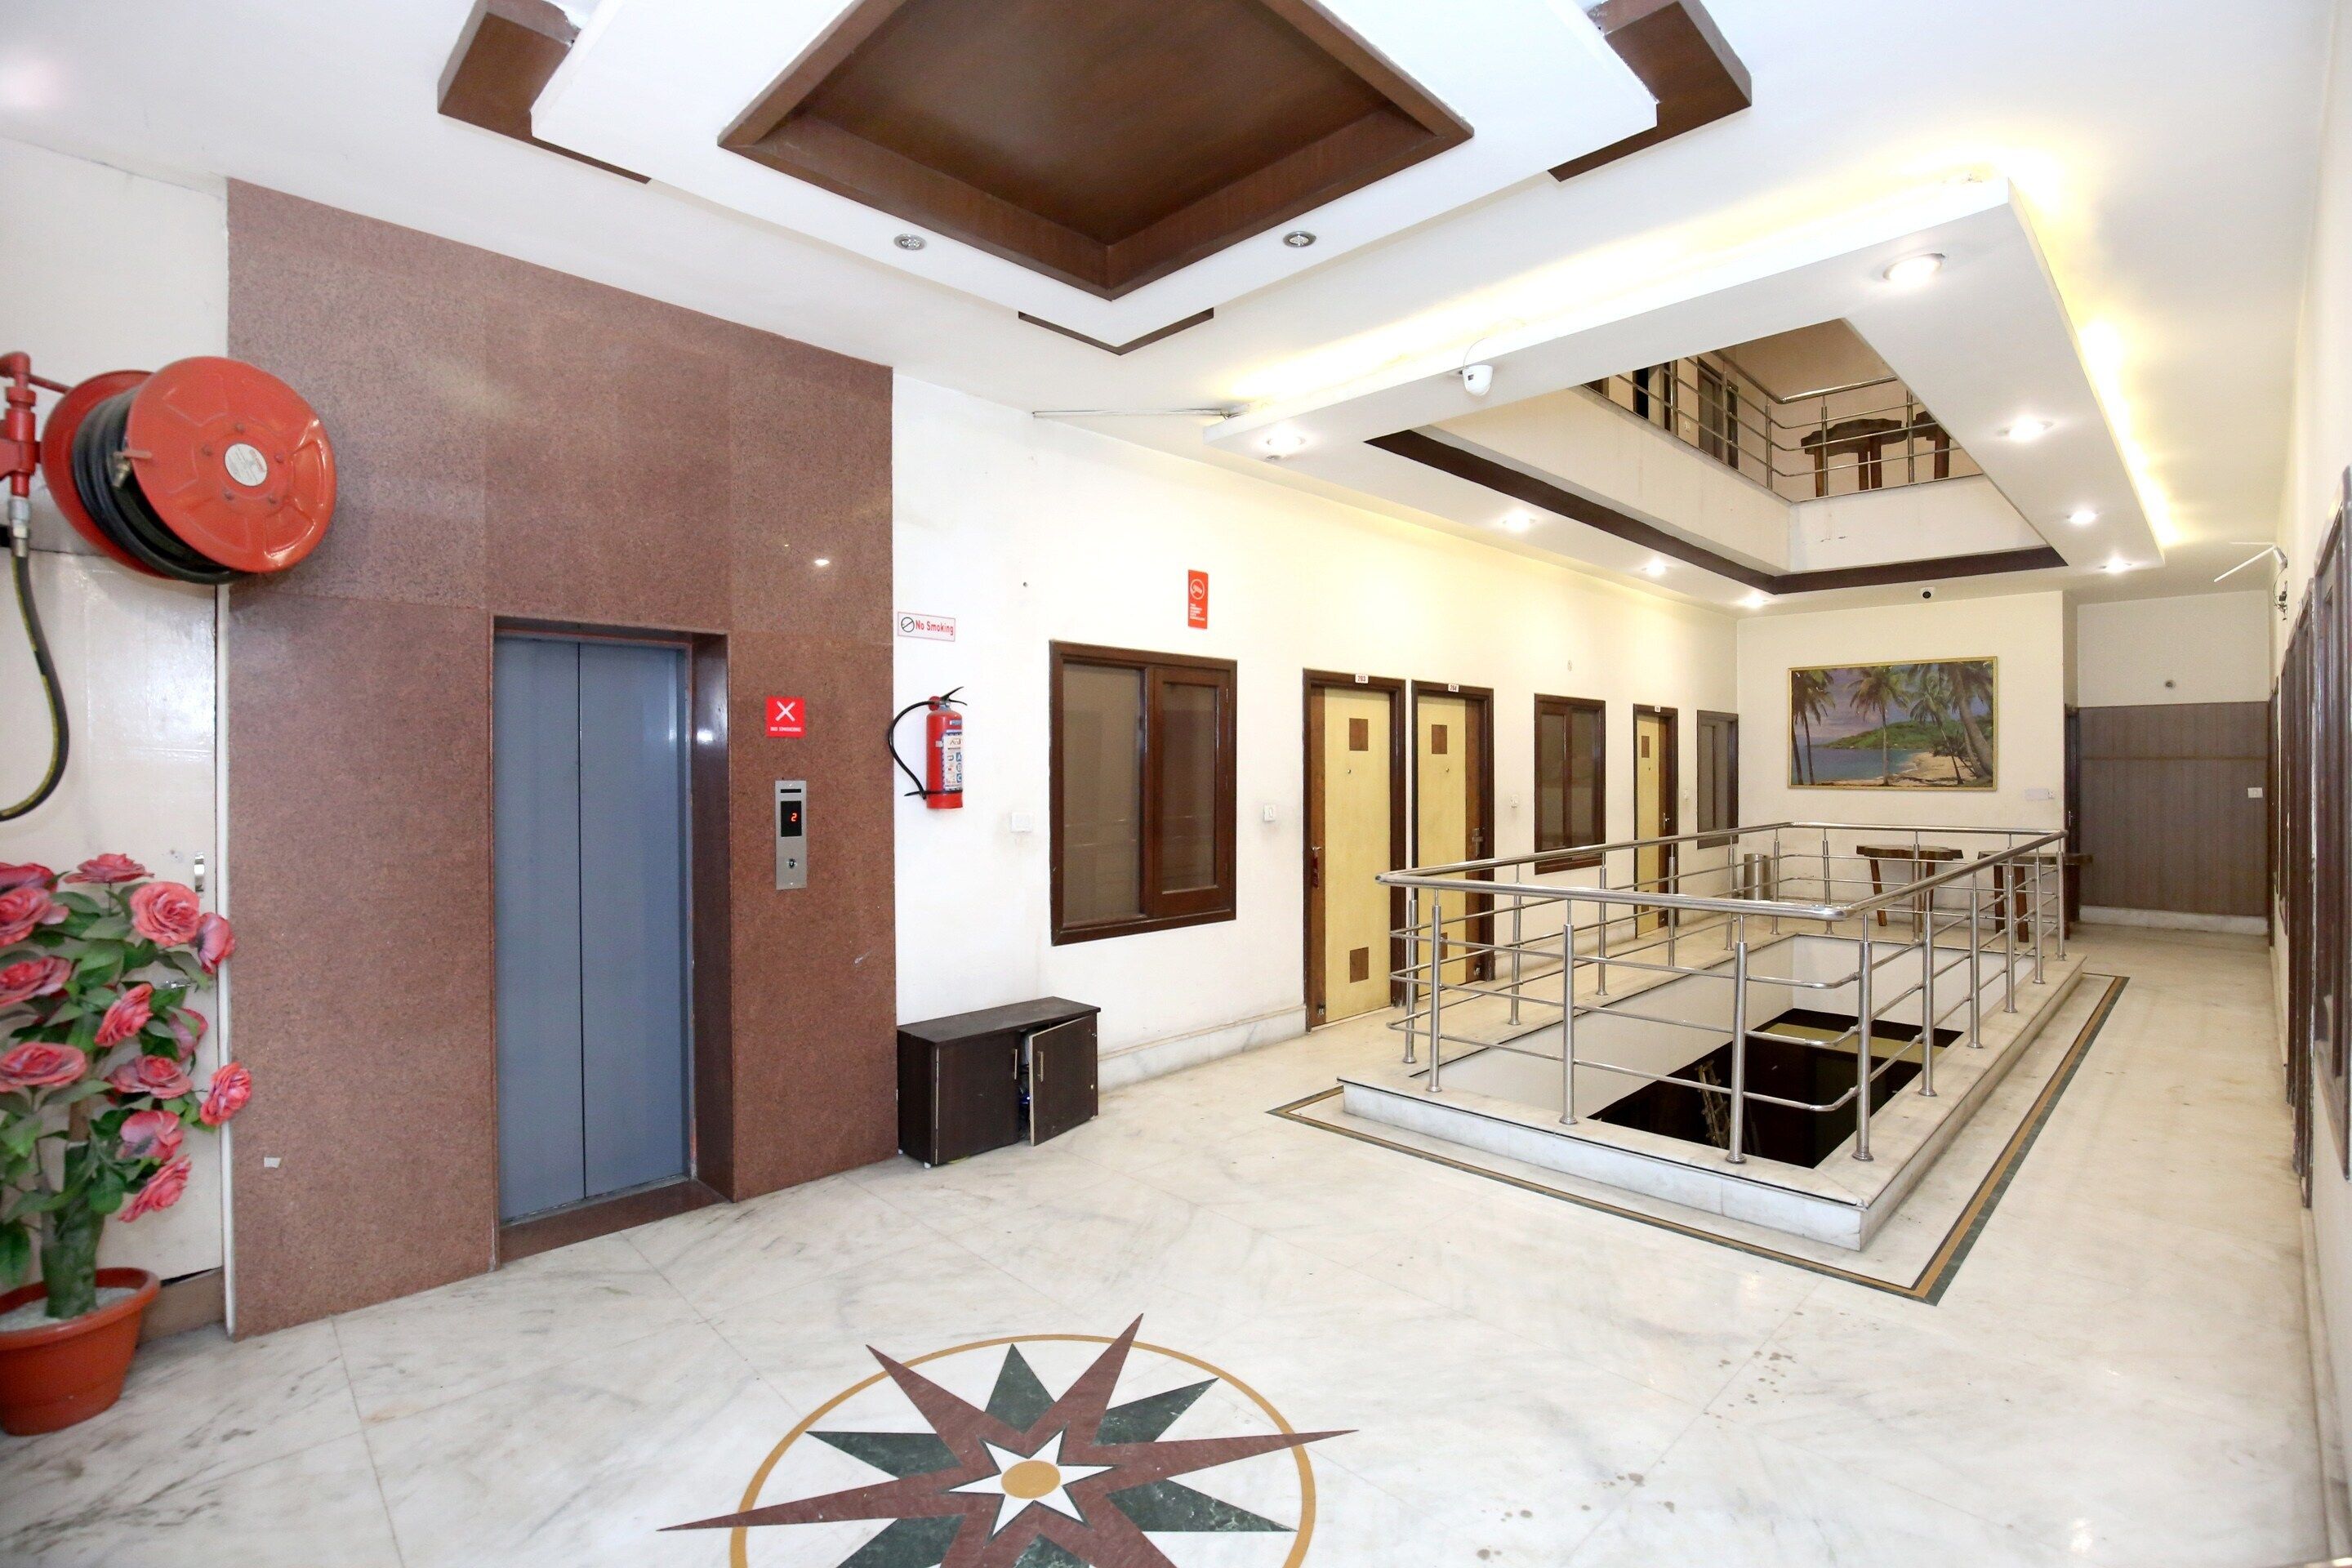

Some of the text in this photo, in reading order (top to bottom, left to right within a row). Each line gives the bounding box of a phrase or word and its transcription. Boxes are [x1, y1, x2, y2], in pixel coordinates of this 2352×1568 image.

[915, 620, 954, 635] No Smoking
[791, 813, 798, 822] 2
